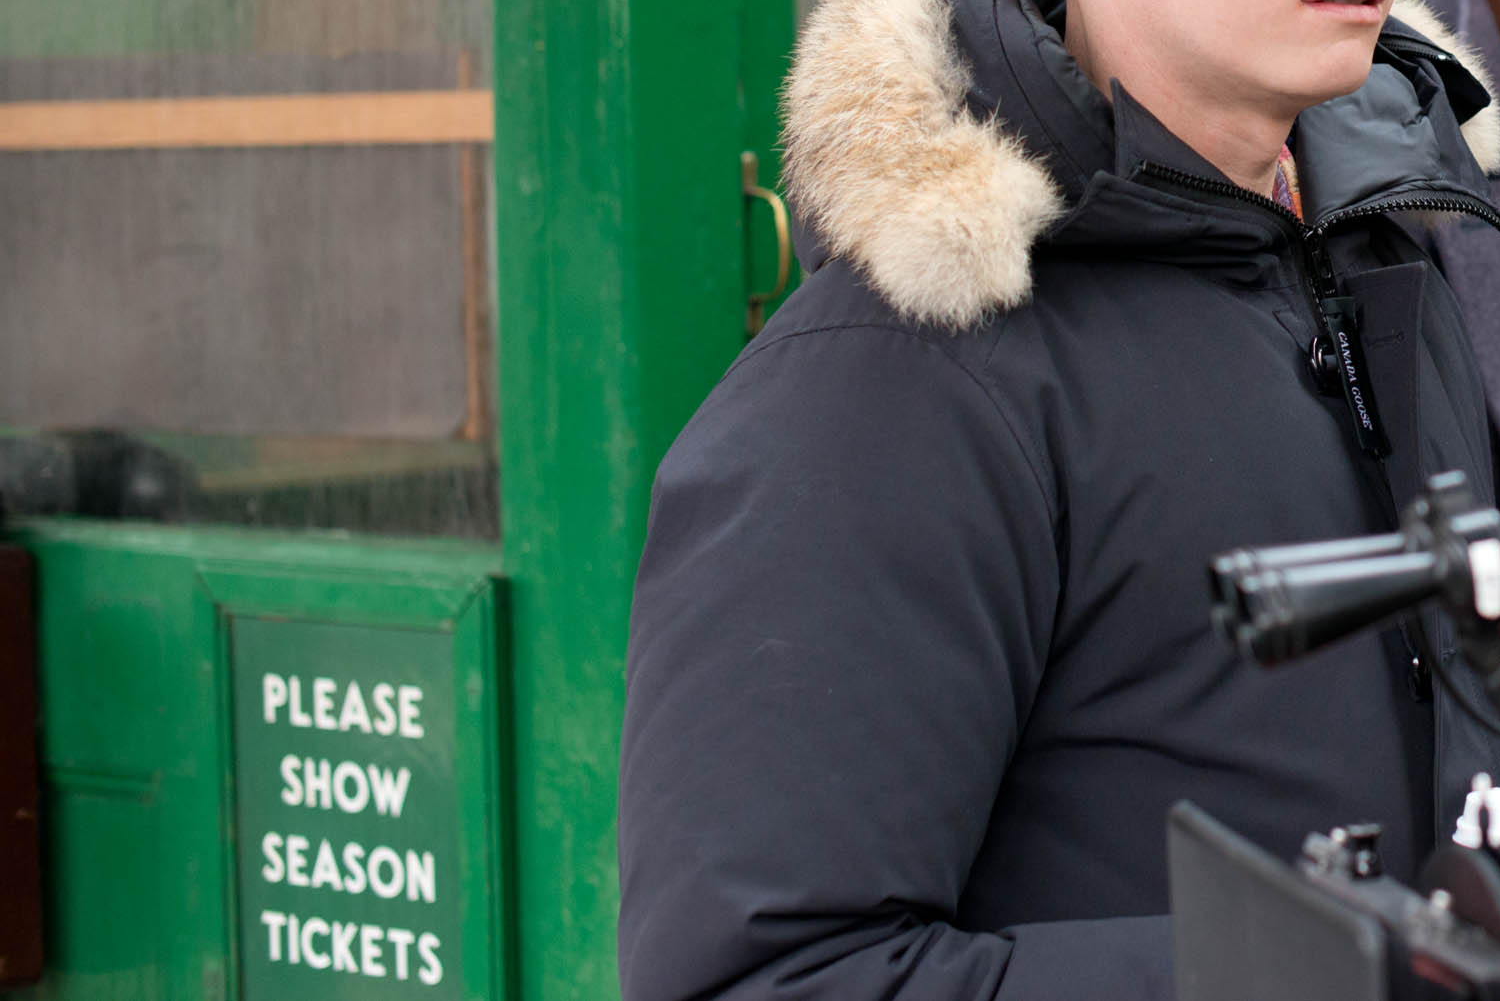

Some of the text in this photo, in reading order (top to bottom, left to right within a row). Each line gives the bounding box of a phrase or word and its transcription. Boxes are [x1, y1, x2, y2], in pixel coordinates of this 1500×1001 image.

[1338, 331, 1371, 429] CANADA GOOSE
[262, 673, 425, 739] PLEASE
[280, 754, 412, 817] SHOW
[261, 831, 436, 903] SEASON
[260, 910, 443, 985] TICKETS
